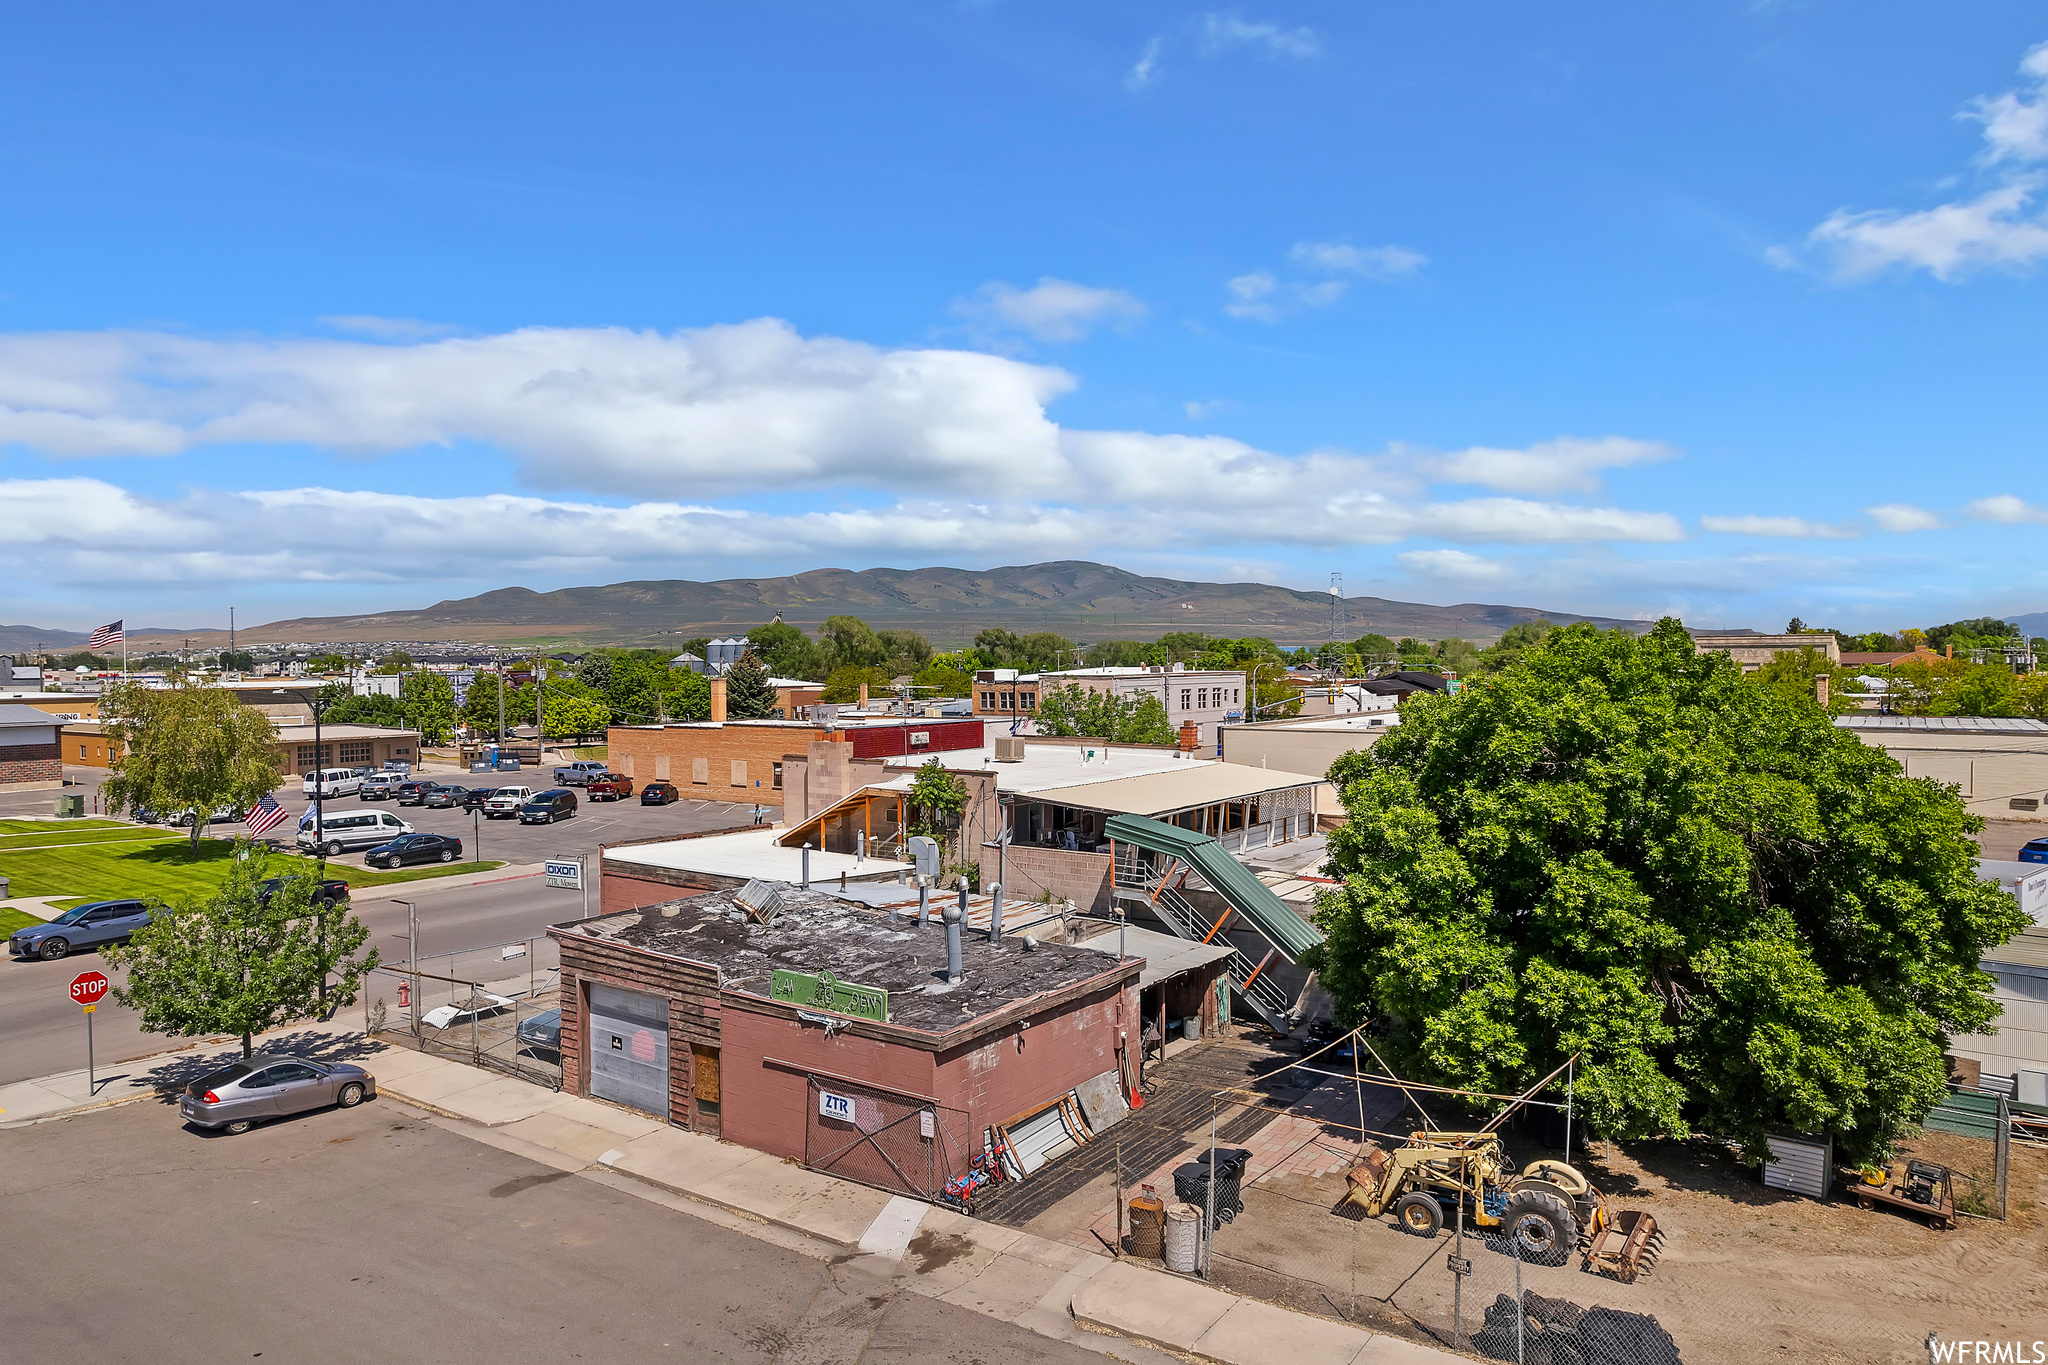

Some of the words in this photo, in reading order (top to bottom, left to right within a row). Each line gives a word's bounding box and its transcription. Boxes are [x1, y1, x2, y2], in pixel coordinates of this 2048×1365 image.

[547, 864, 576, 876] DIXON
[72, 979, 107, 997] STOP
[825, 1094, 848, 1114] ZTR
